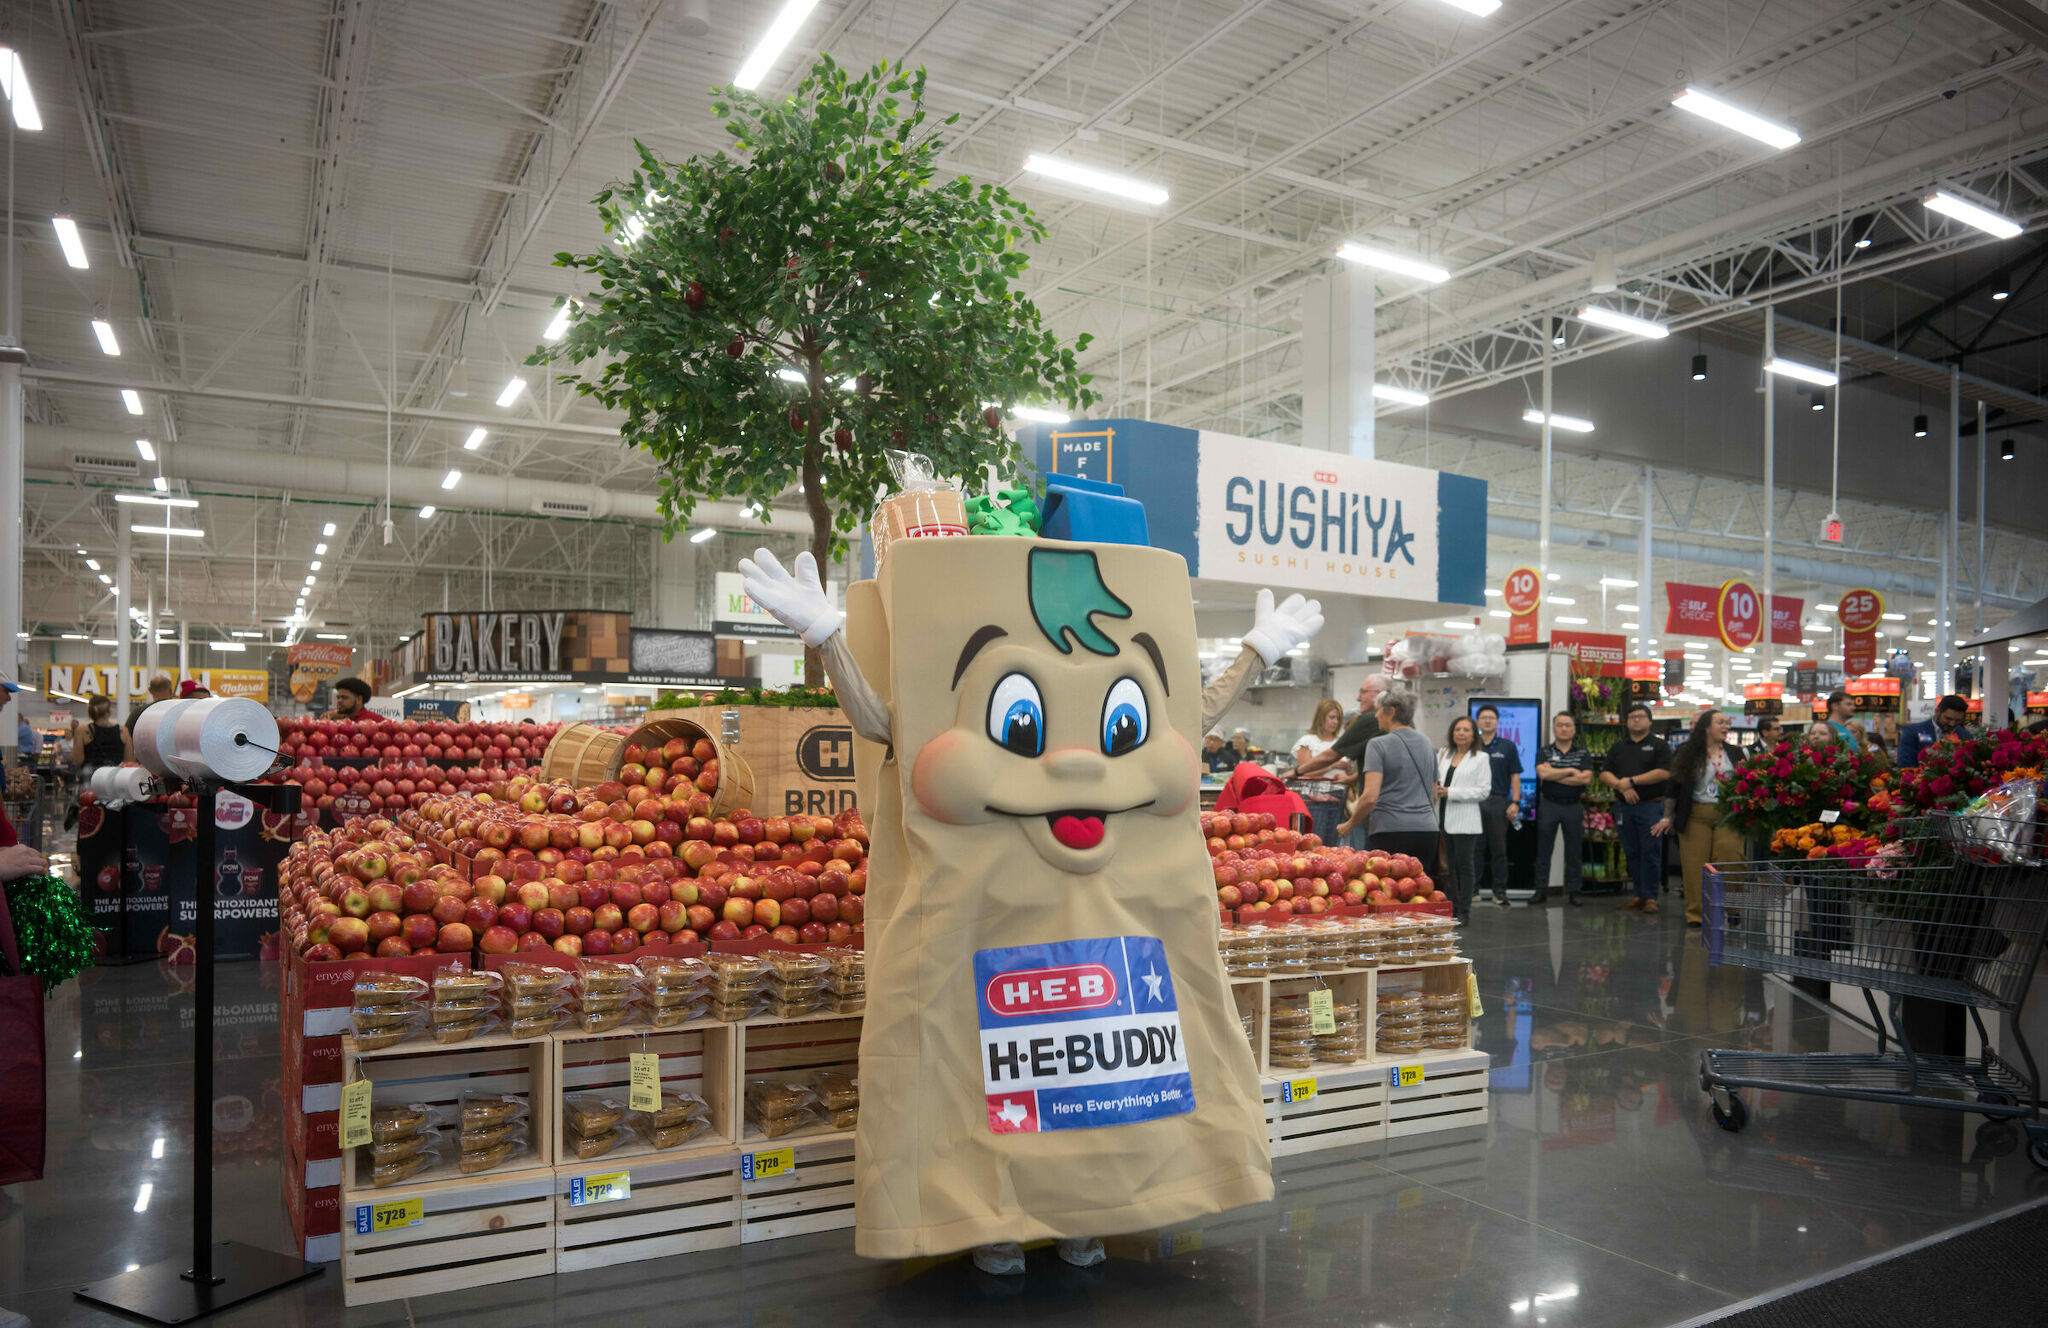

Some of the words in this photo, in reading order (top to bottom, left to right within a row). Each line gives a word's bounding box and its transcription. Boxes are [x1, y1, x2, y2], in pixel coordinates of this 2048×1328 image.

[1063, 442, 1101, 452] MADE
[1238, 551, 1308, 569] SUSHI
[1327, 562, 1396, 579] HOUSE
[1511, 574, 1533, 594] 10
[1688, 601, 1708, 611] SELF
[1730, 592, 1754, 619] 10
[1845, 595, 1873, 613] 25
[434, 613, 565, 671] BAKERY
[1581, 649, 1623, 660] DRINKS
[664, 676, 696, 684] FRESH
[220, 680, 264, 694] Natural
[419, 702, 439, 710] HOT
[1755, 700, 1766, 709] 10
[214, 899, 279, 908] NTIOXIDANT
[316, 973, 343, 984] envy
[313, 1048, 340, 1059] envy
[1052, 1102, 1083, 1114] Here
[1087, 1092, 1159, 1112] Everything's
[315, 1198, 339, 1208] envy
